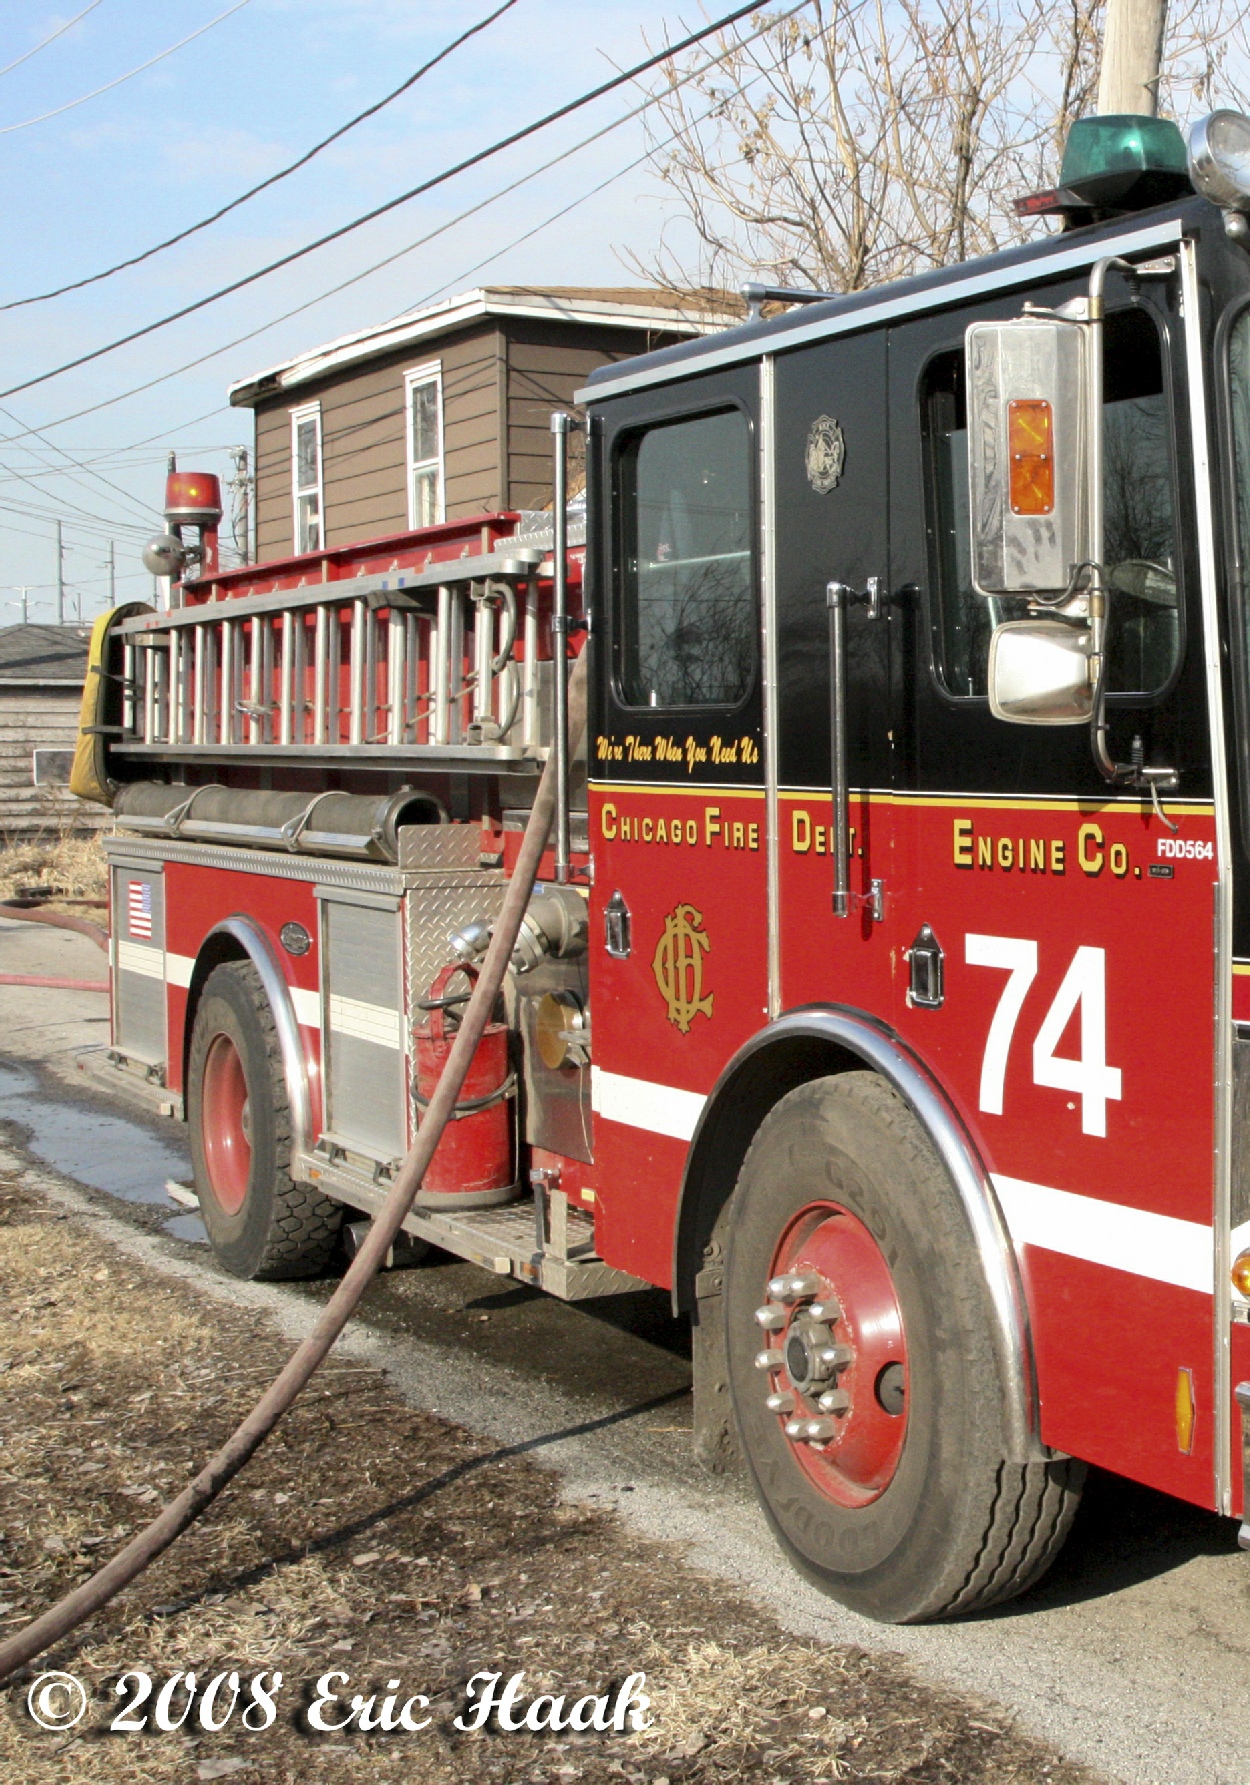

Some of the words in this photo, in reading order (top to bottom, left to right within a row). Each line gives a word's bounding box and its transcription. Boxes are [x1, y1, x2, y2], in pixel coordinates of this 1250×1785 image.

[595, 735, 623, 761] We're
[625, 735, 652, 762] There
[654, 735, 683, 762] When
[685, 735, 707, 774] You
[710, 735, 738, 765] Need
[740, 735, 760, 764] Us
[601, 803, 698, 845] CHICAGO
[705, 807, 759, 850] FIRE
[953, 819, 1065, 875] ENGINE
[1078, 823, 1141, 877] CO.
[1157, 838, 1214, 860] FDD564
[965, 932, 1122, 1139] 74
